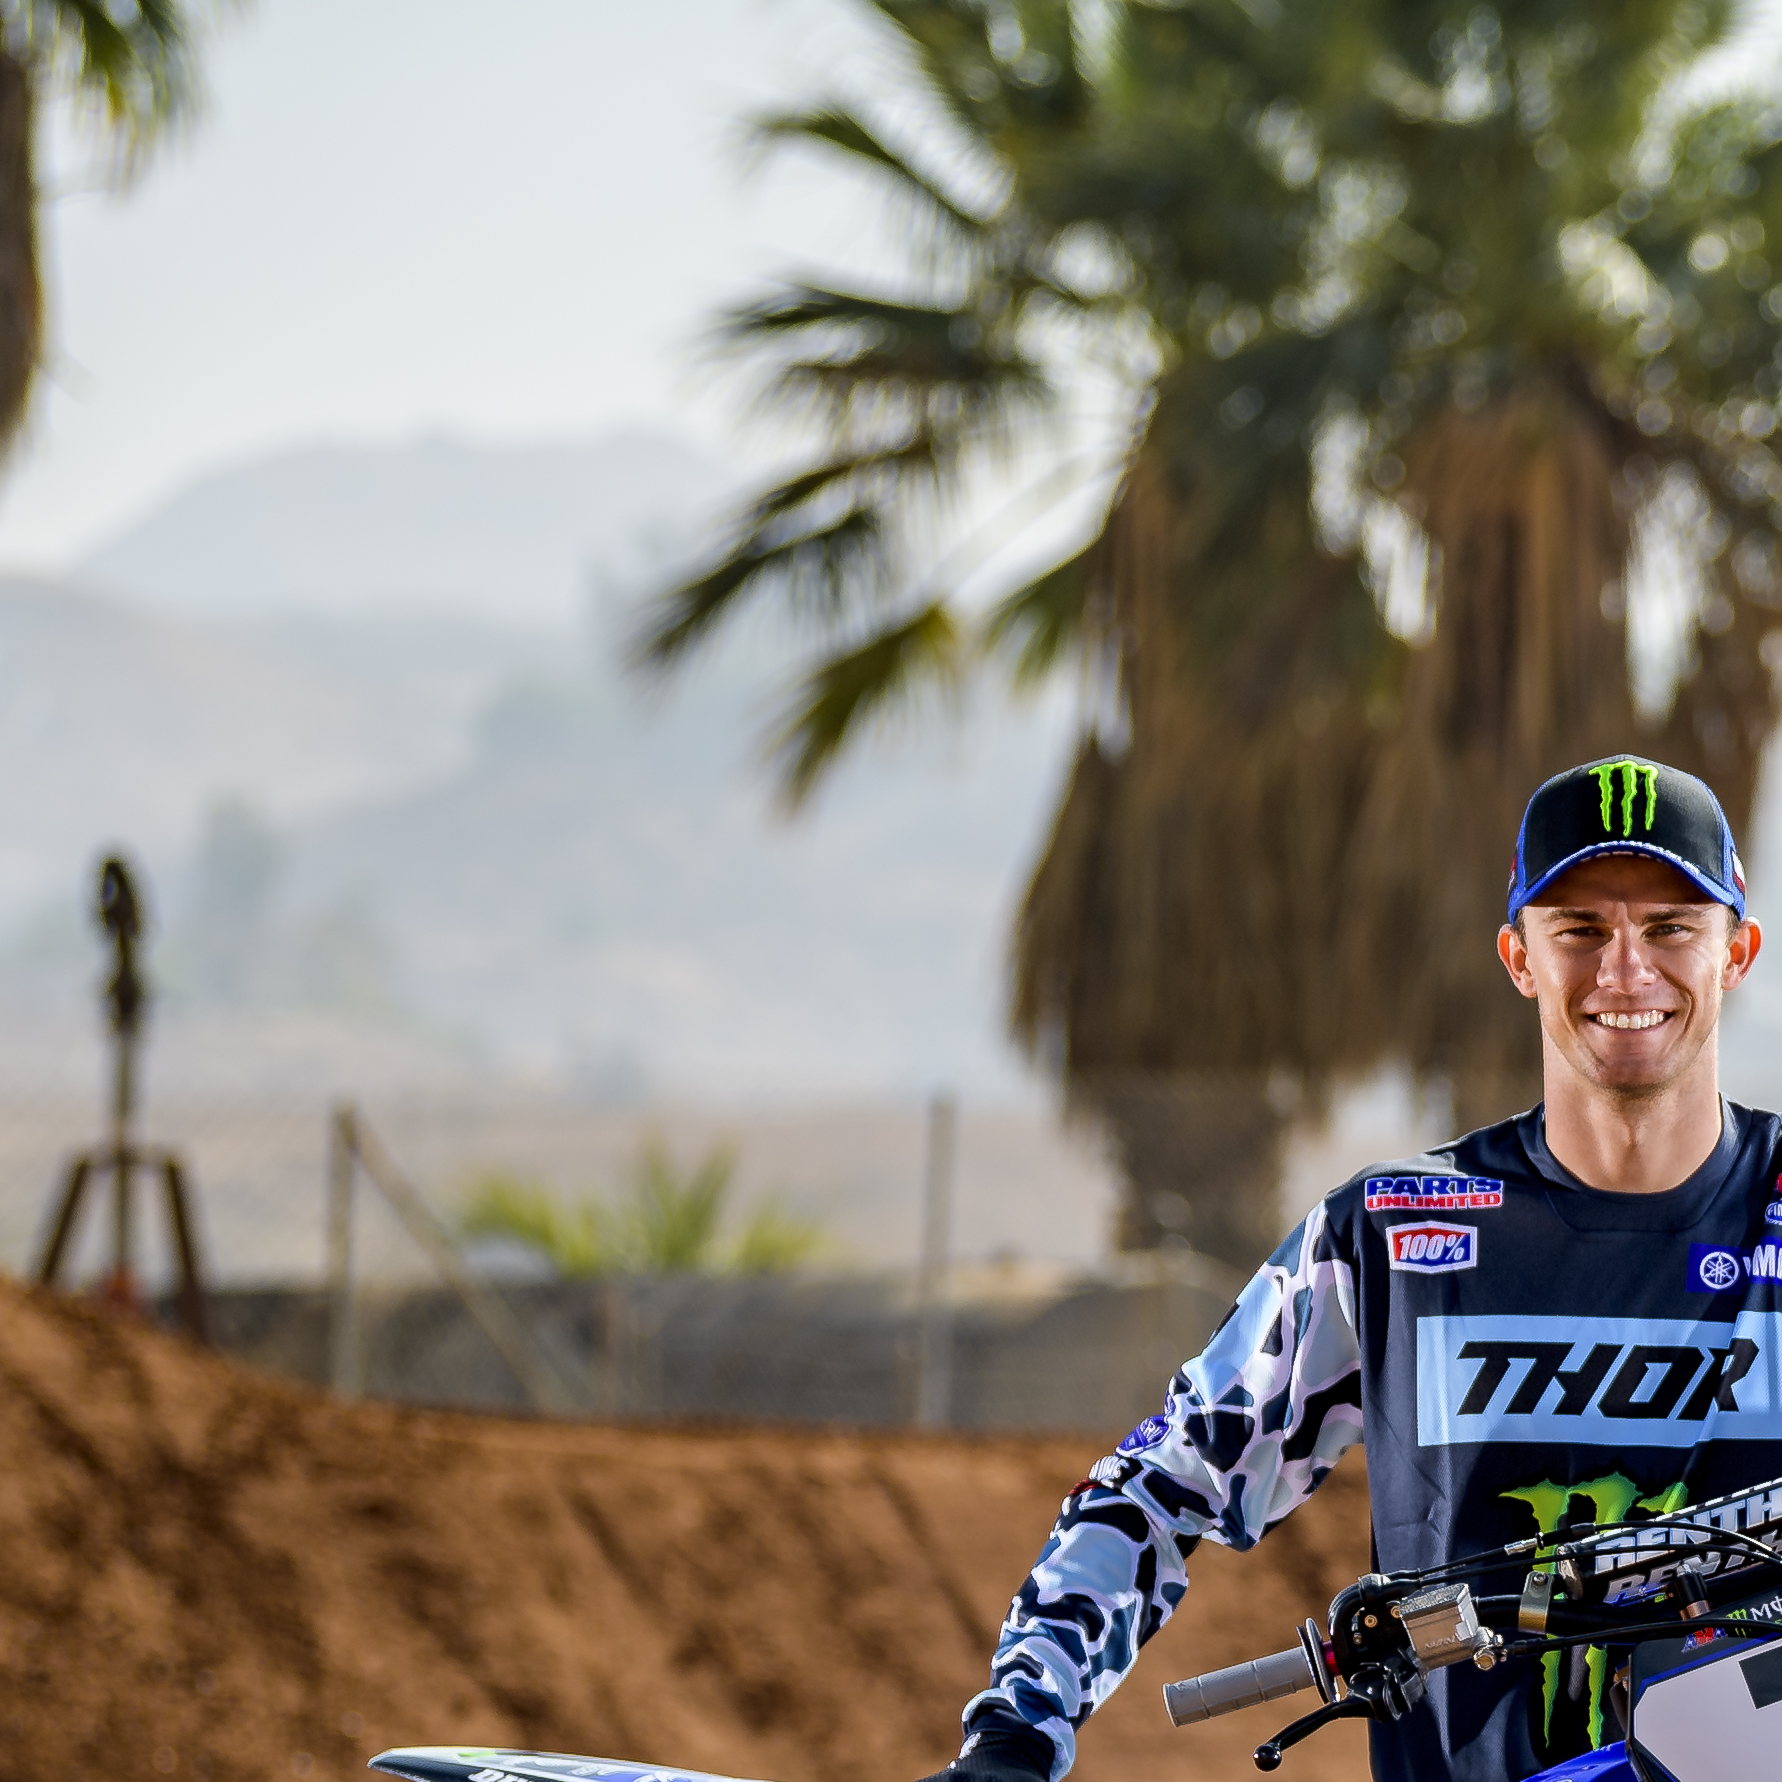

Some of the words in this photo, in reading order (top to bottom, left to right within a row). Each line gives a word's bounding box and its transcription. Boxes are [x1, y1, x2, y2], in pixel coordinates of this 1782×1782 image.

[1366, 1176, 1503, 1197] PARTS
[1366, 1194, 1502, 1211] UNLIMITED
[1396, 1231, 1466, 1262] 100%
[1456, 1338, 1759, 1421] THOR
